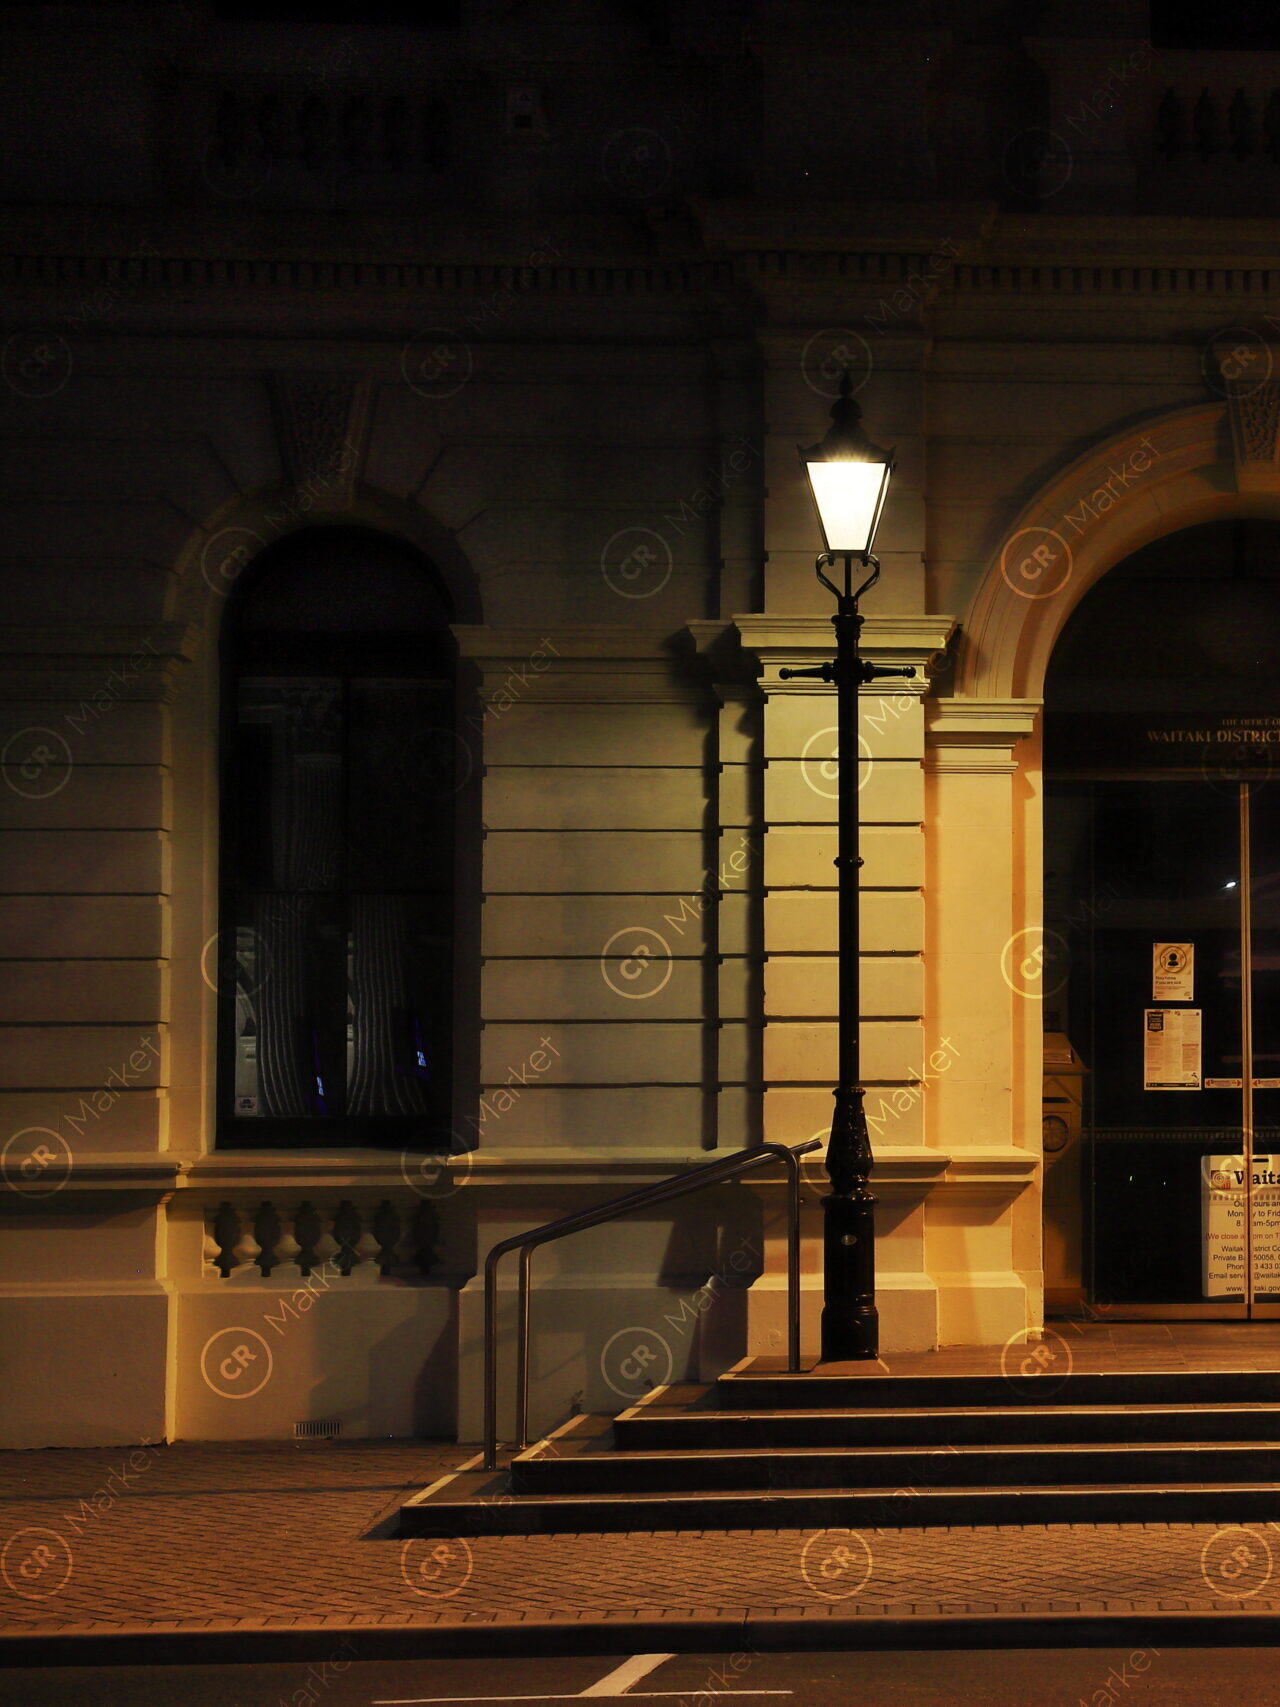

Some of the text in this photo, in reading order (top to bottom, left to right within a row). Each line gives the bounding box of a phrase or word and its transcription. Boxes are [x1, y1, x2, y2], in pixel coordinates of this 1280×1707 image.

[1146, 730, 1212, 743] WAITAKI
[1233, 1200, 1247, 1208] Ou
[1250, 1200, 1270, 1208] ours
[1227, 1210, 1257, 1218] Mony
